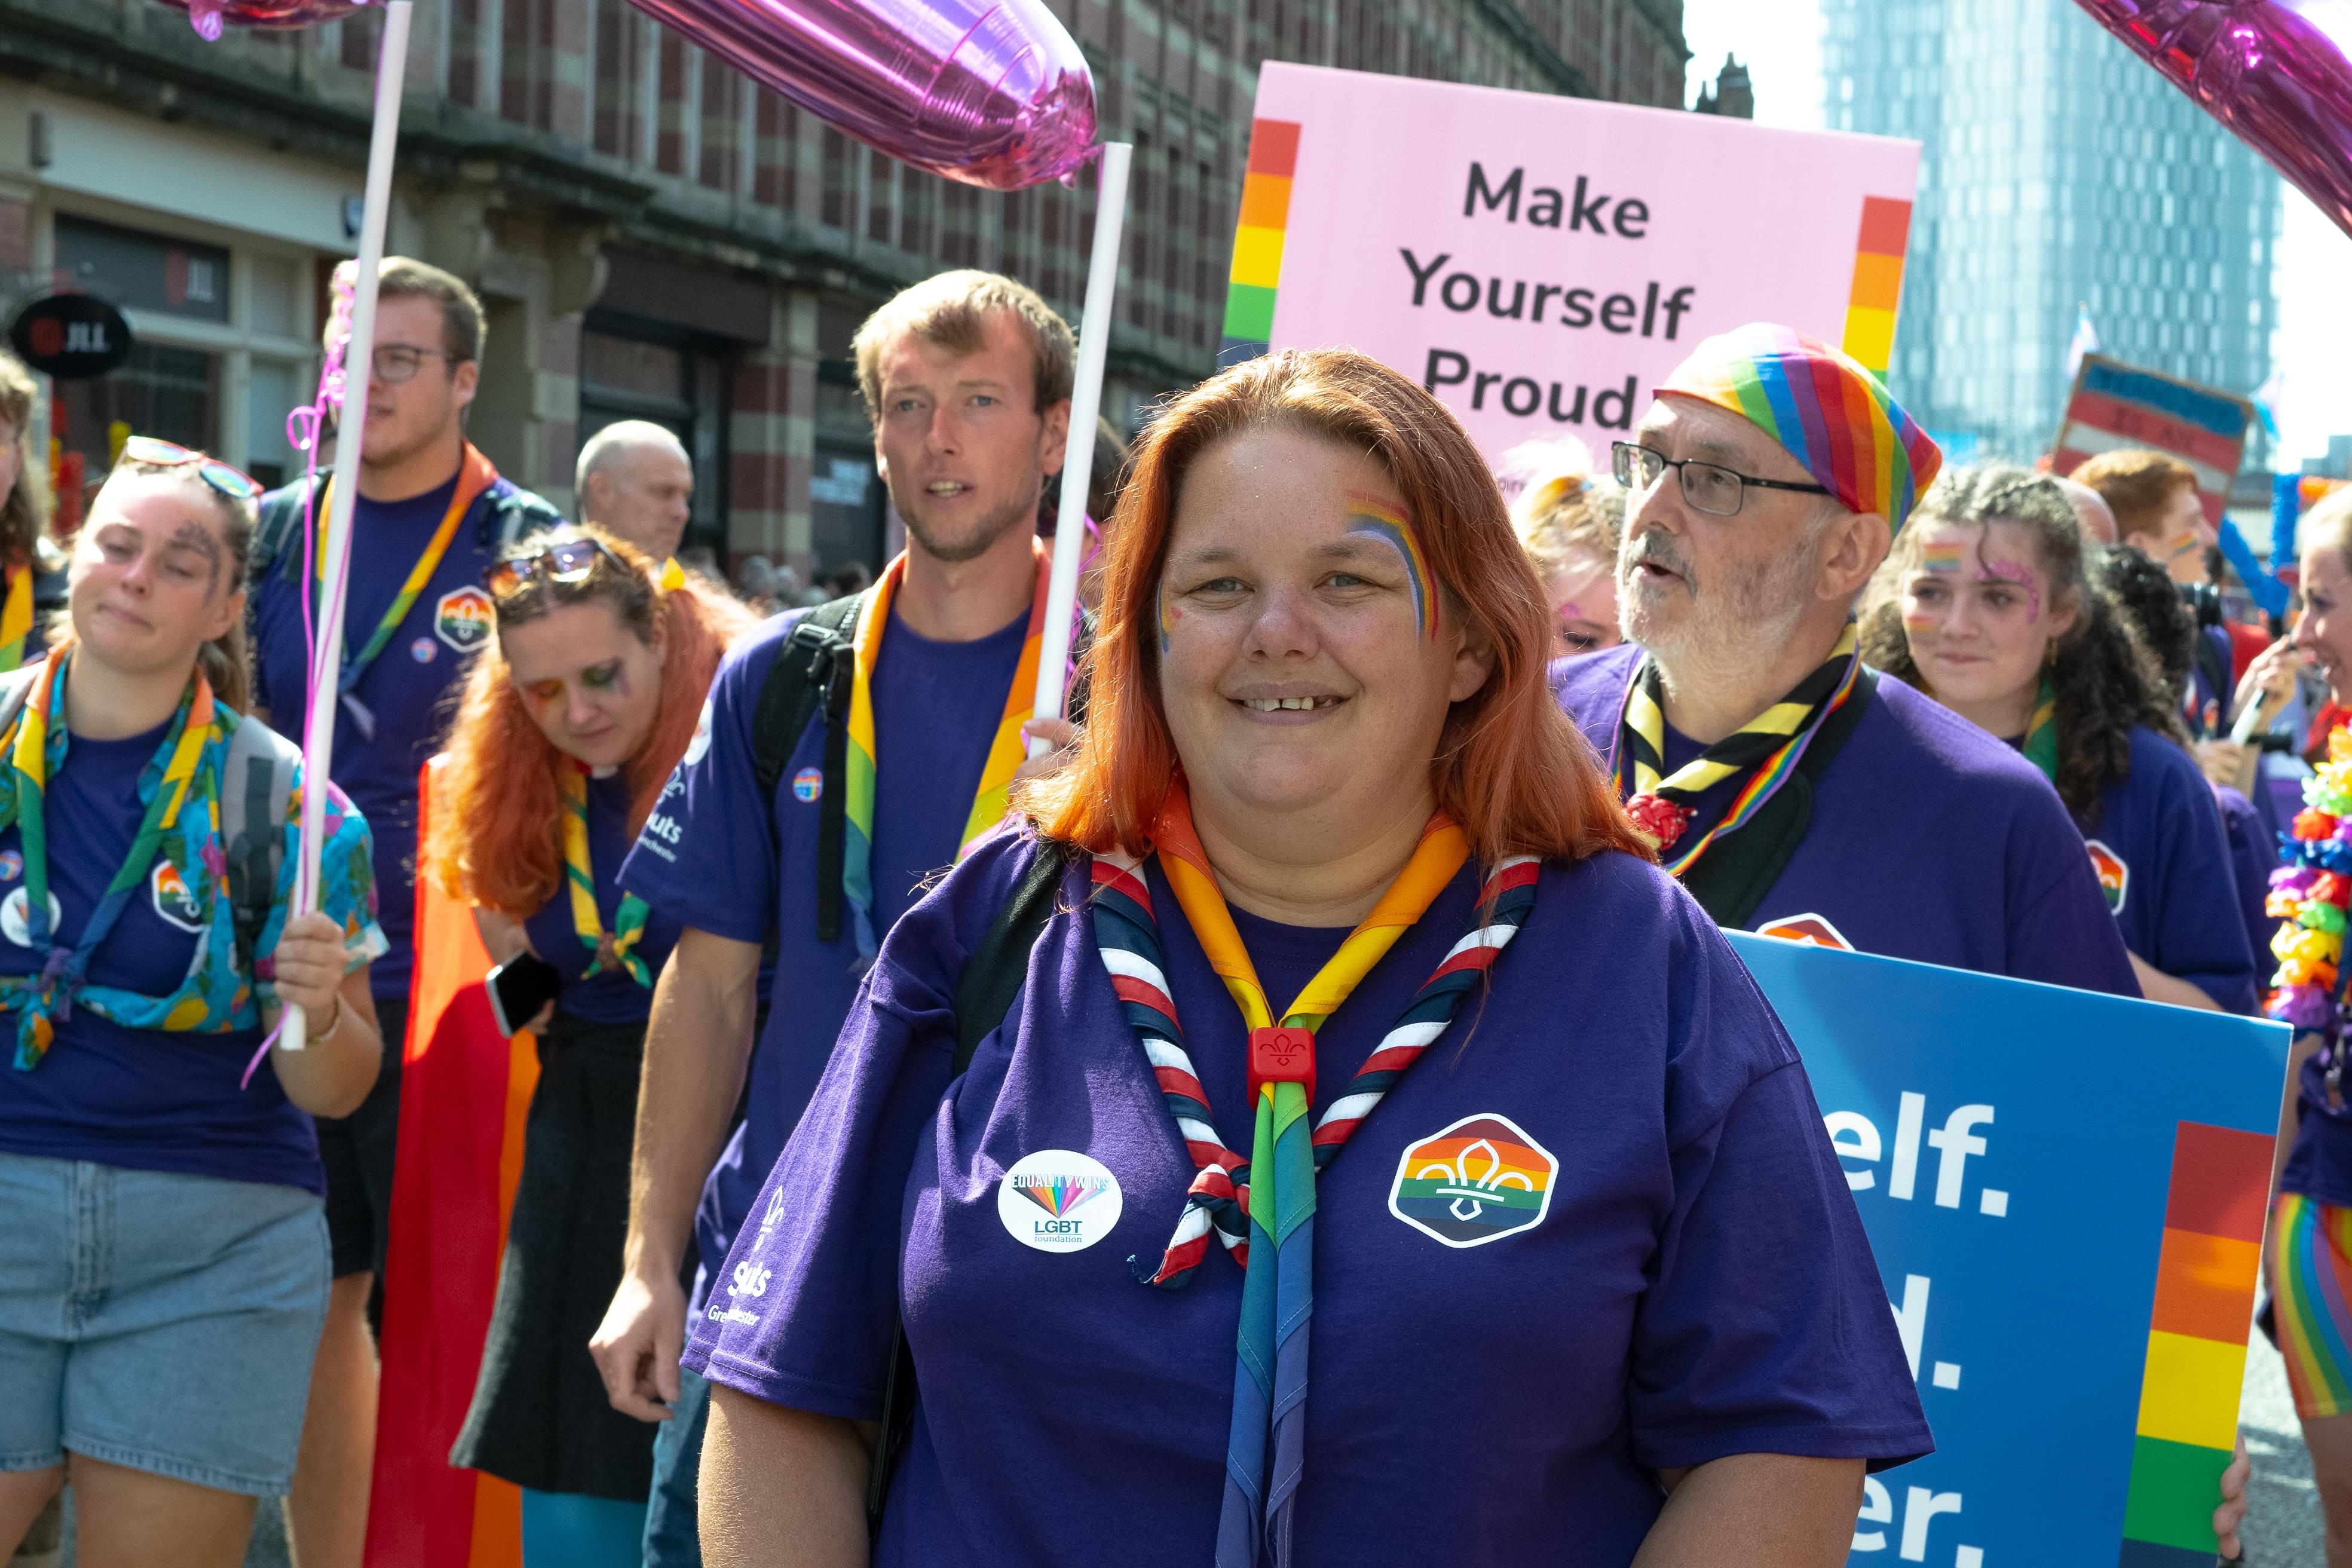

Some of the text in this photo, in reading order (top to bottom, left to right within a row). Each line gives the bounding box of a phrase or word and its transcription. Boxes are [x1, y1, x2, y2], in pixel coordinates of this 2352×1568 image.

[1463, 161, 1650, 240] Make
[1398, 247, 1696, 341] Yourself
[1424, 348, 1639, 431] Proud
[1010, 1173, 1110, 1190] EQUALITY WINS
[1034, 1220, 1083, 1233] LGBT
